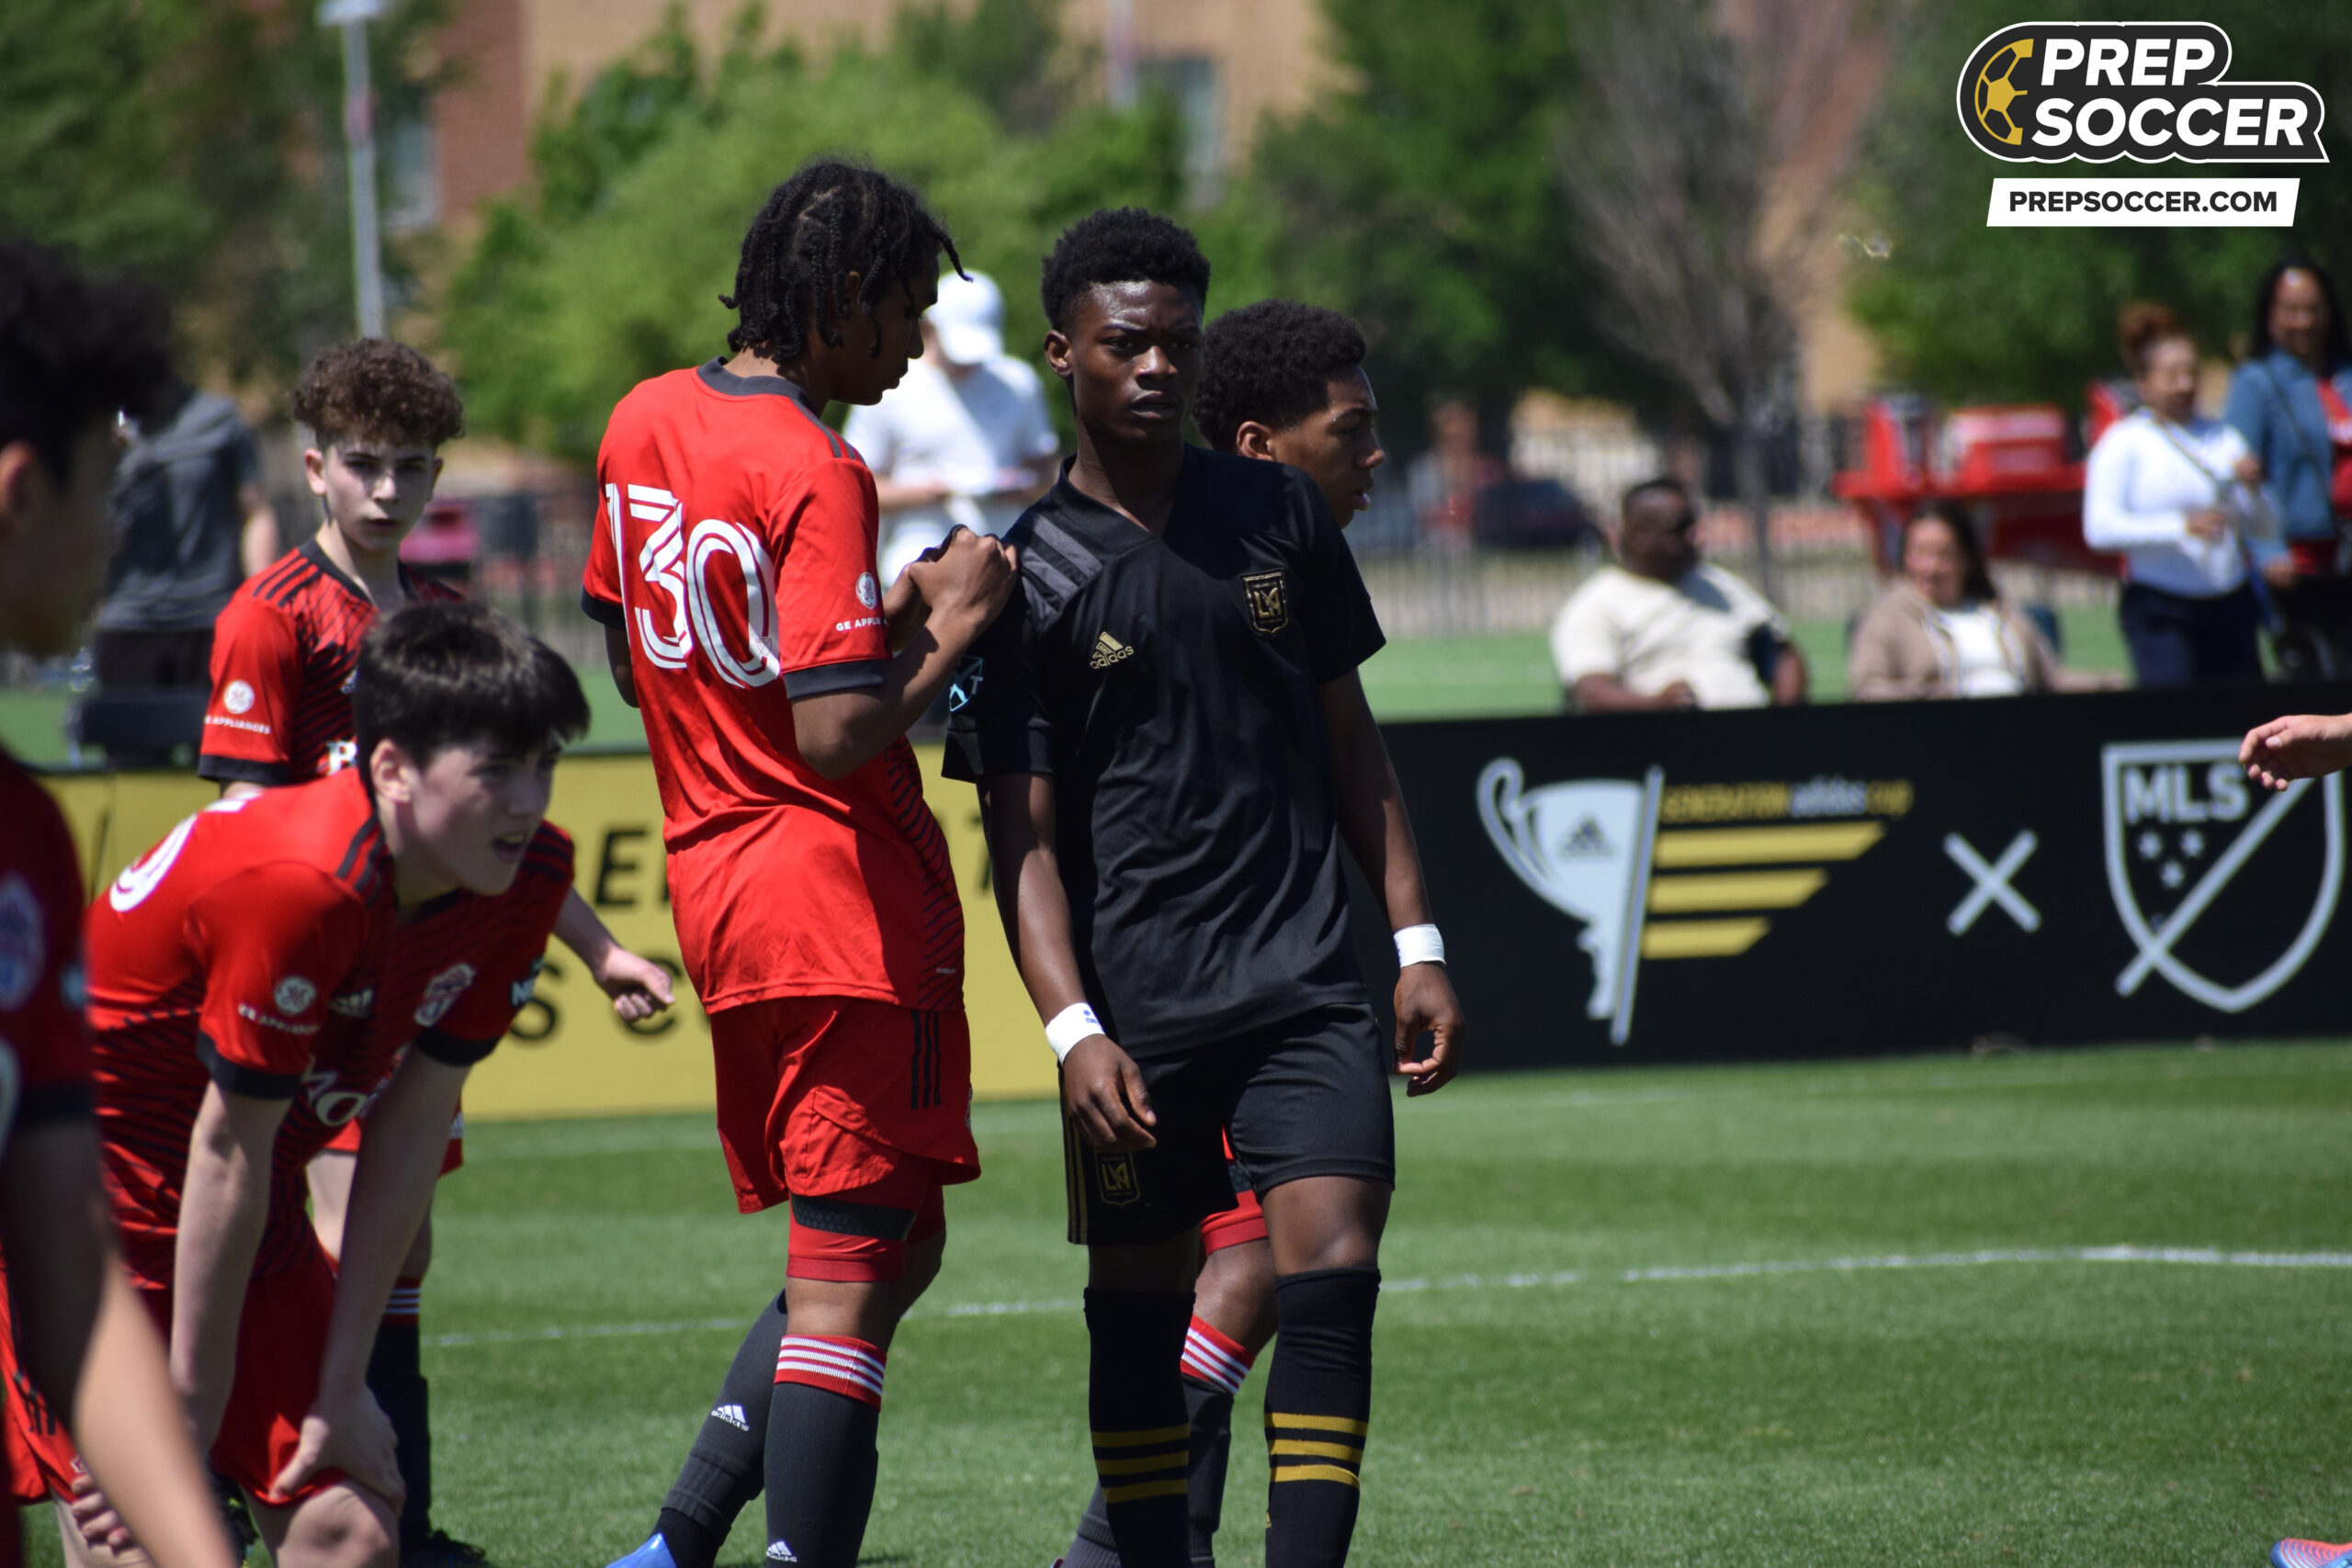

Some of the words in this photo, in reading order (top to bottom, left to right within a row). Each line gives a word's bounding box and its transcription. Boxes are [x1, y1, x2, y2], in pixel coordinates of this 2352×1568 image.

[835, 620, 852, 632] GE
[1090, 646, 1135, 670] adidas
[212, 716, 271, 735] APPLIANCES
[2123, 762, 2251, 824] MLS
